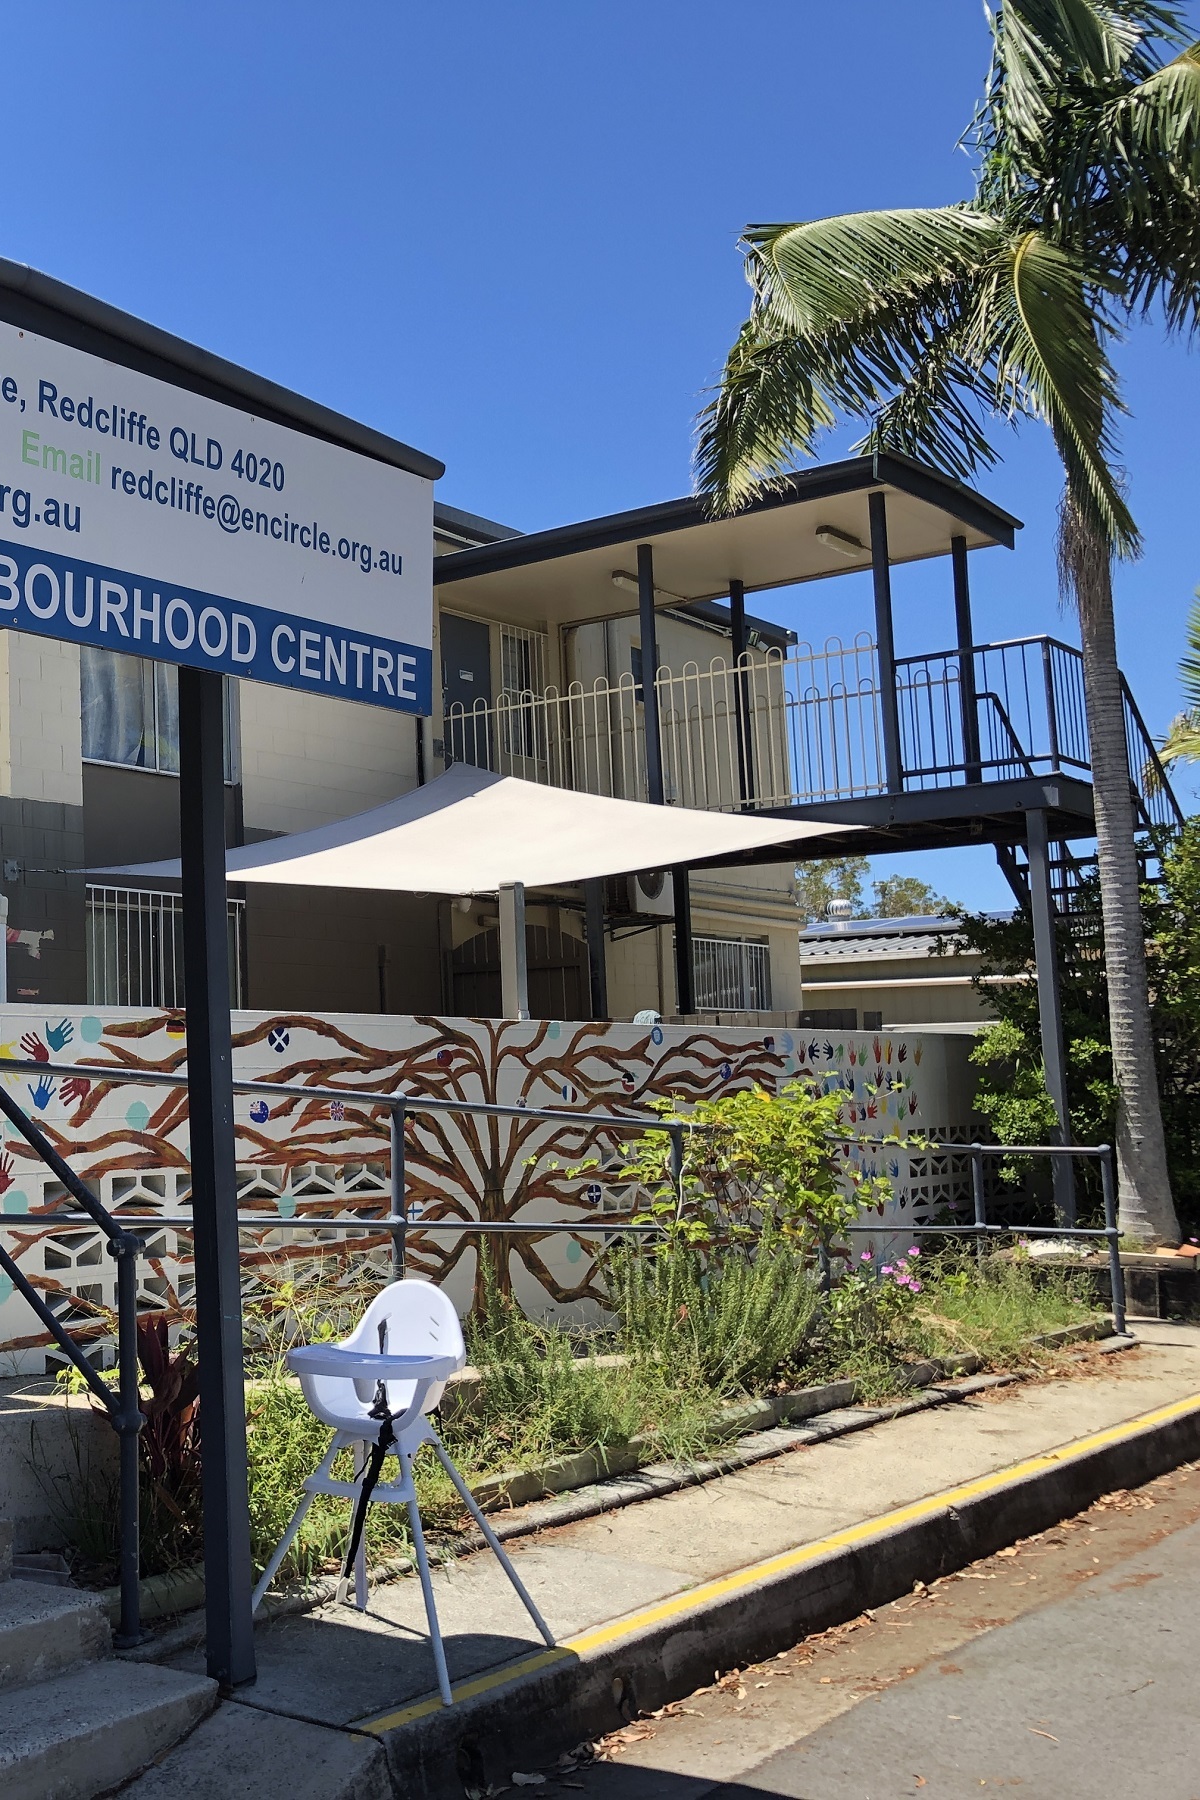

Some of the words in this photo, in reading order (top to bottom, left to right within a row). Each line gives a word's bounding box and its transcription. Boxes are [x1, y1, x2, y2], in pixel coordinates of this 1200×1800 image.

[38, 379, 161, 451] Redcliffe
[169, 427, 223, 471] QLD
[230, 448, 285, 492] 4020
[21, 427, 102, 486] Email
[111, 465, 403, 577] redcliffe@encircle.org.au
[271, 624, 417, 701] CENTRE
